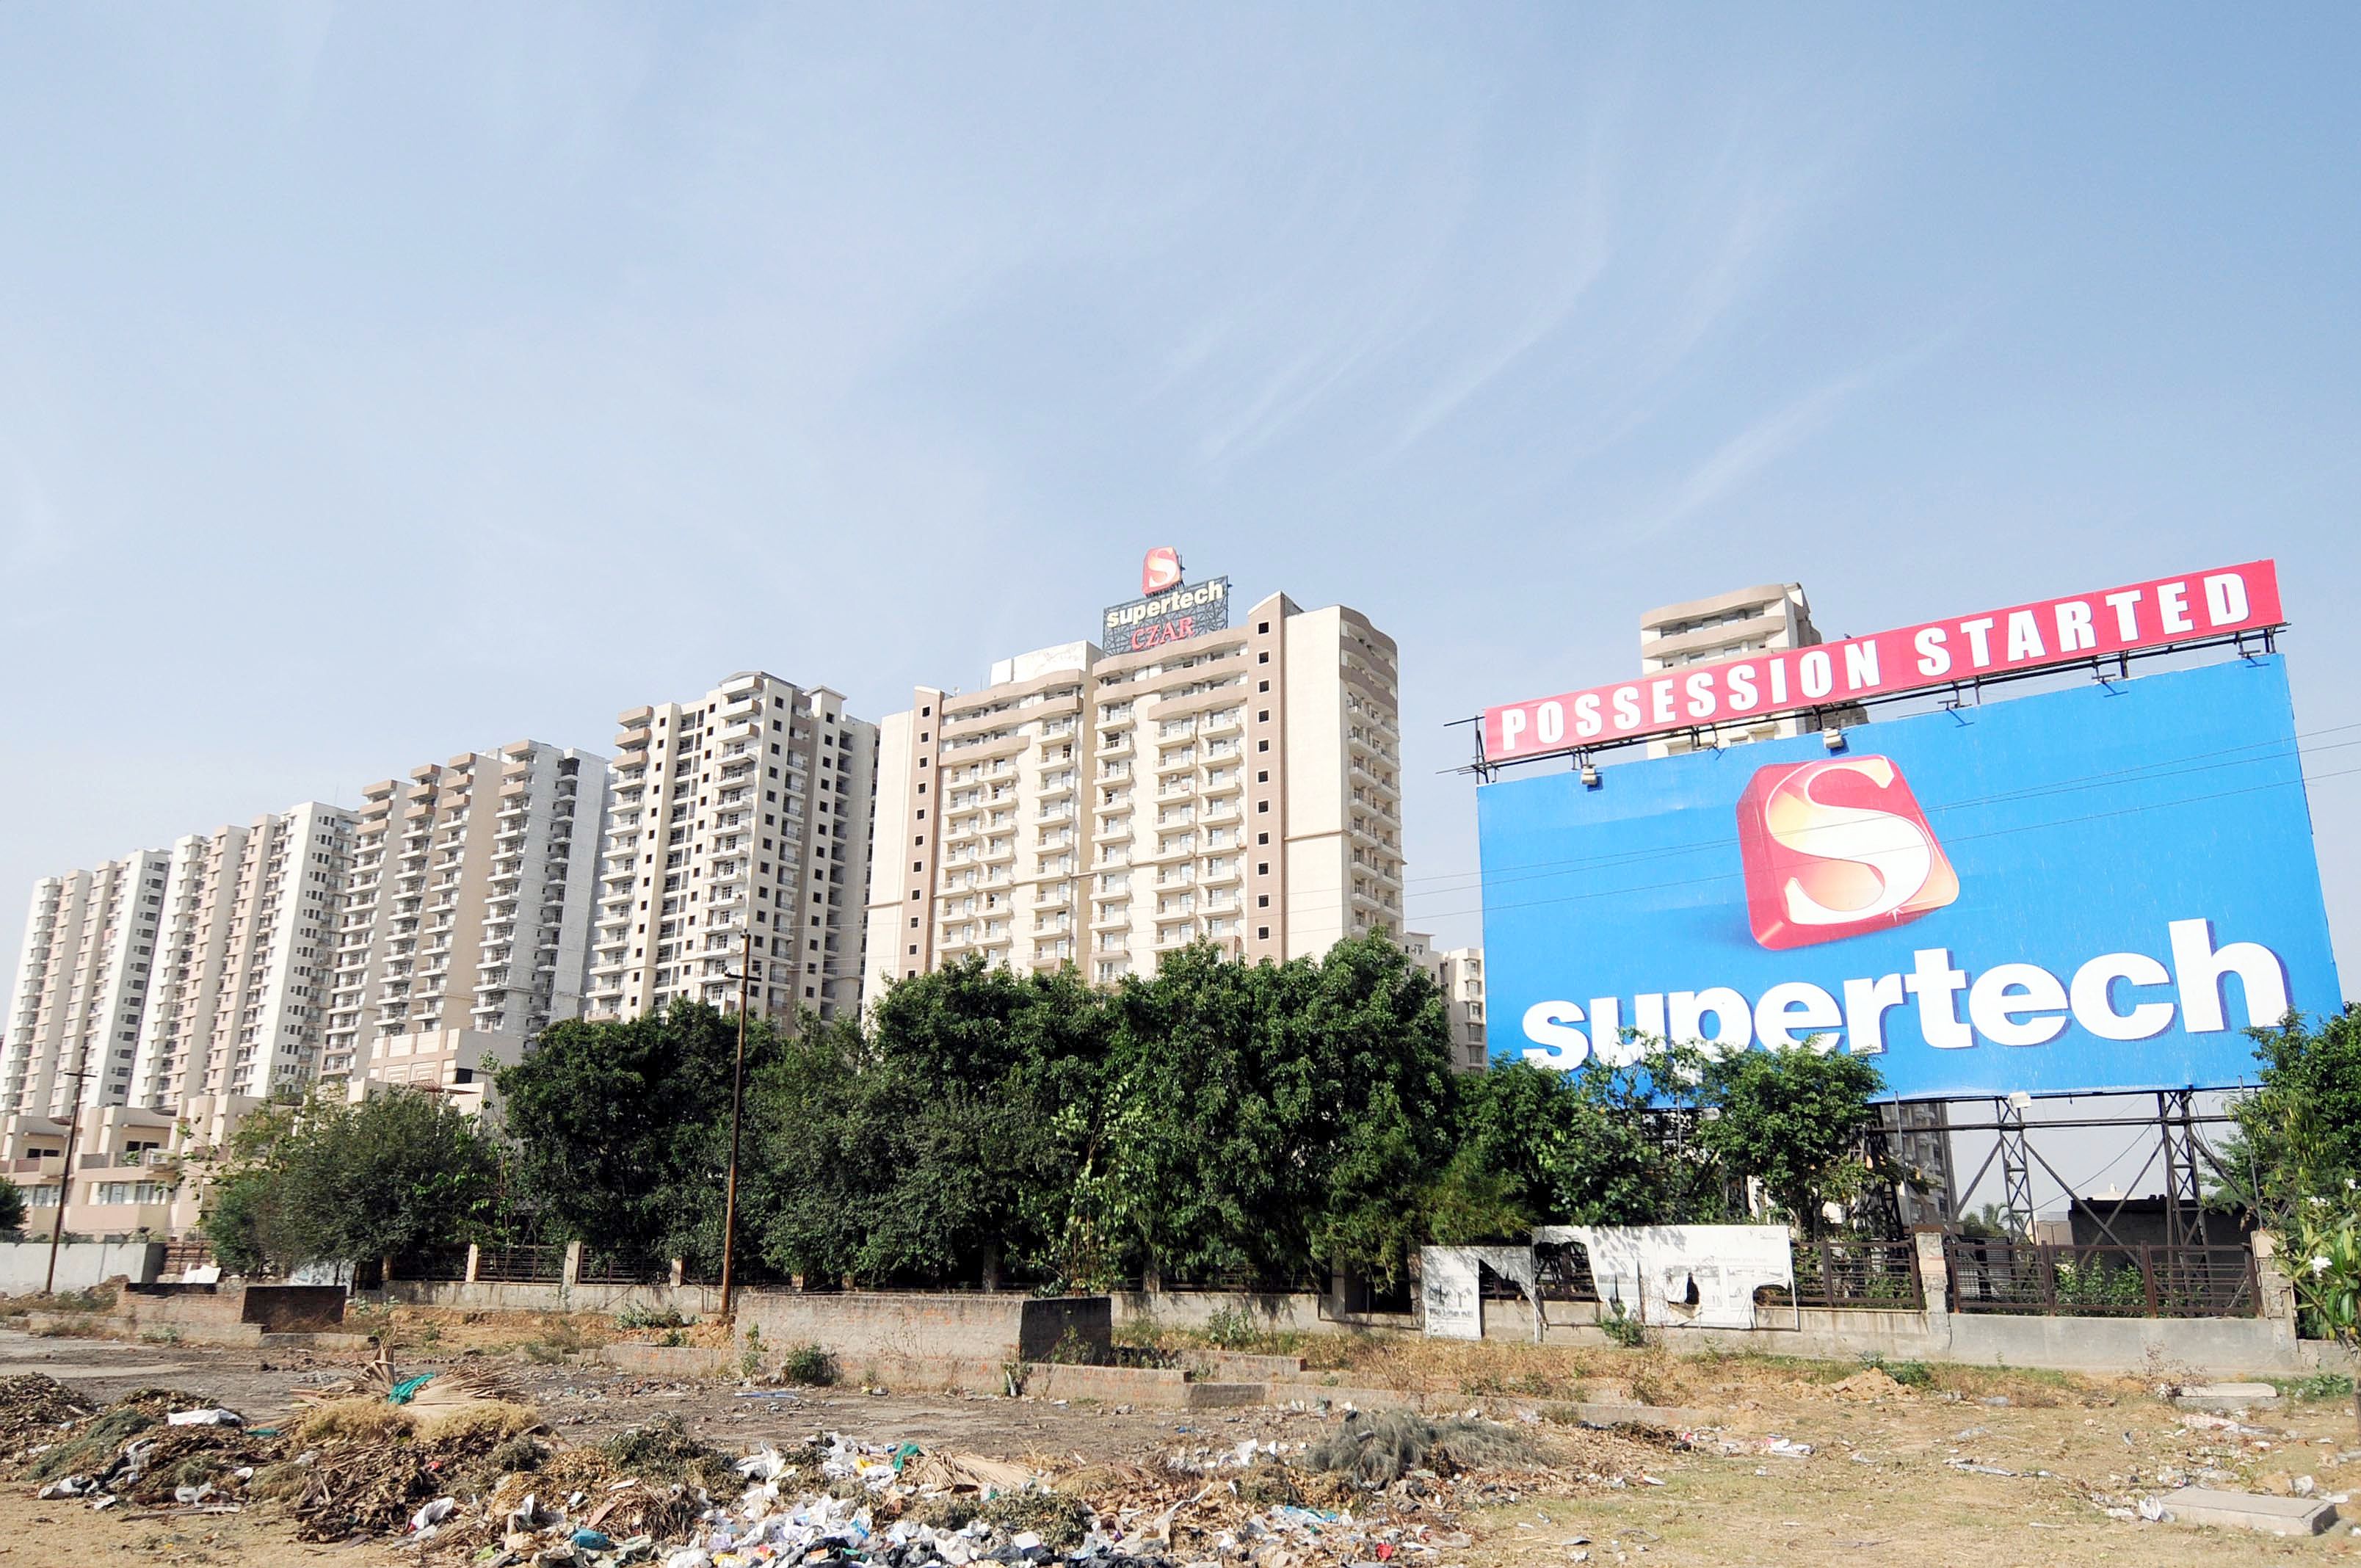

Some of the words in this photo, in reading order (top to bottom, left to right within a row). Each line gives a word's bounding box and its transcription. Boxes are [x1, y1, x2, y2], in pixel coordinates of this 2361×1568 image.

[1106, 581, 1223, 628] supertech
[1149, 547, 1178, 588] S
[1131, 617, 1194, 651] CZAR
[1501, 640, 1881, 752] POSSESSION
[1914, 572, 2252, 677] STARTED
[1765, 756, 1932, 925] S
[1522, 918, 2293, 1086] supertech
